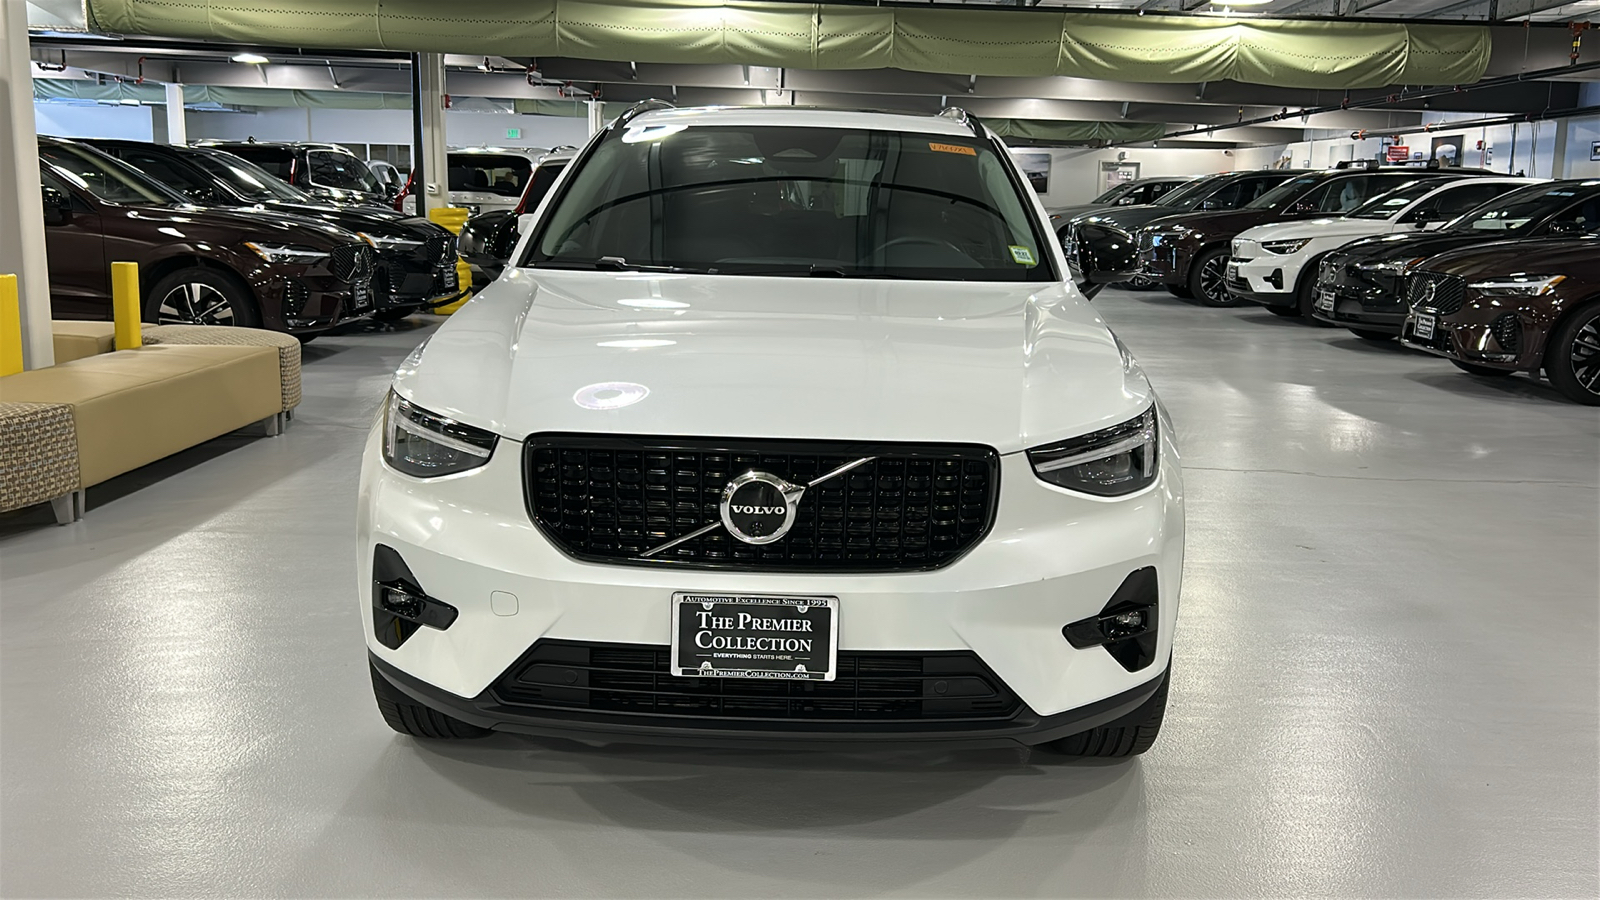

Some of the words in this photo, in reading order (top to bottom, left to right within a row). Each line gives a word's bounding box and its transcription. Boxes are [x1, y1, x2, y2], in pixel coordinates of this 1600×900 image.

[731, 505, 785, 514] VOLVO
[696, 611, 734, 630] THE
[737, 612, 813, 632] PREMIER
[695, 630, 813, 652] COLLECTION
[713, 652, 752, 660] EVERYTHING
[752, 653, 775, 661] STARTS
